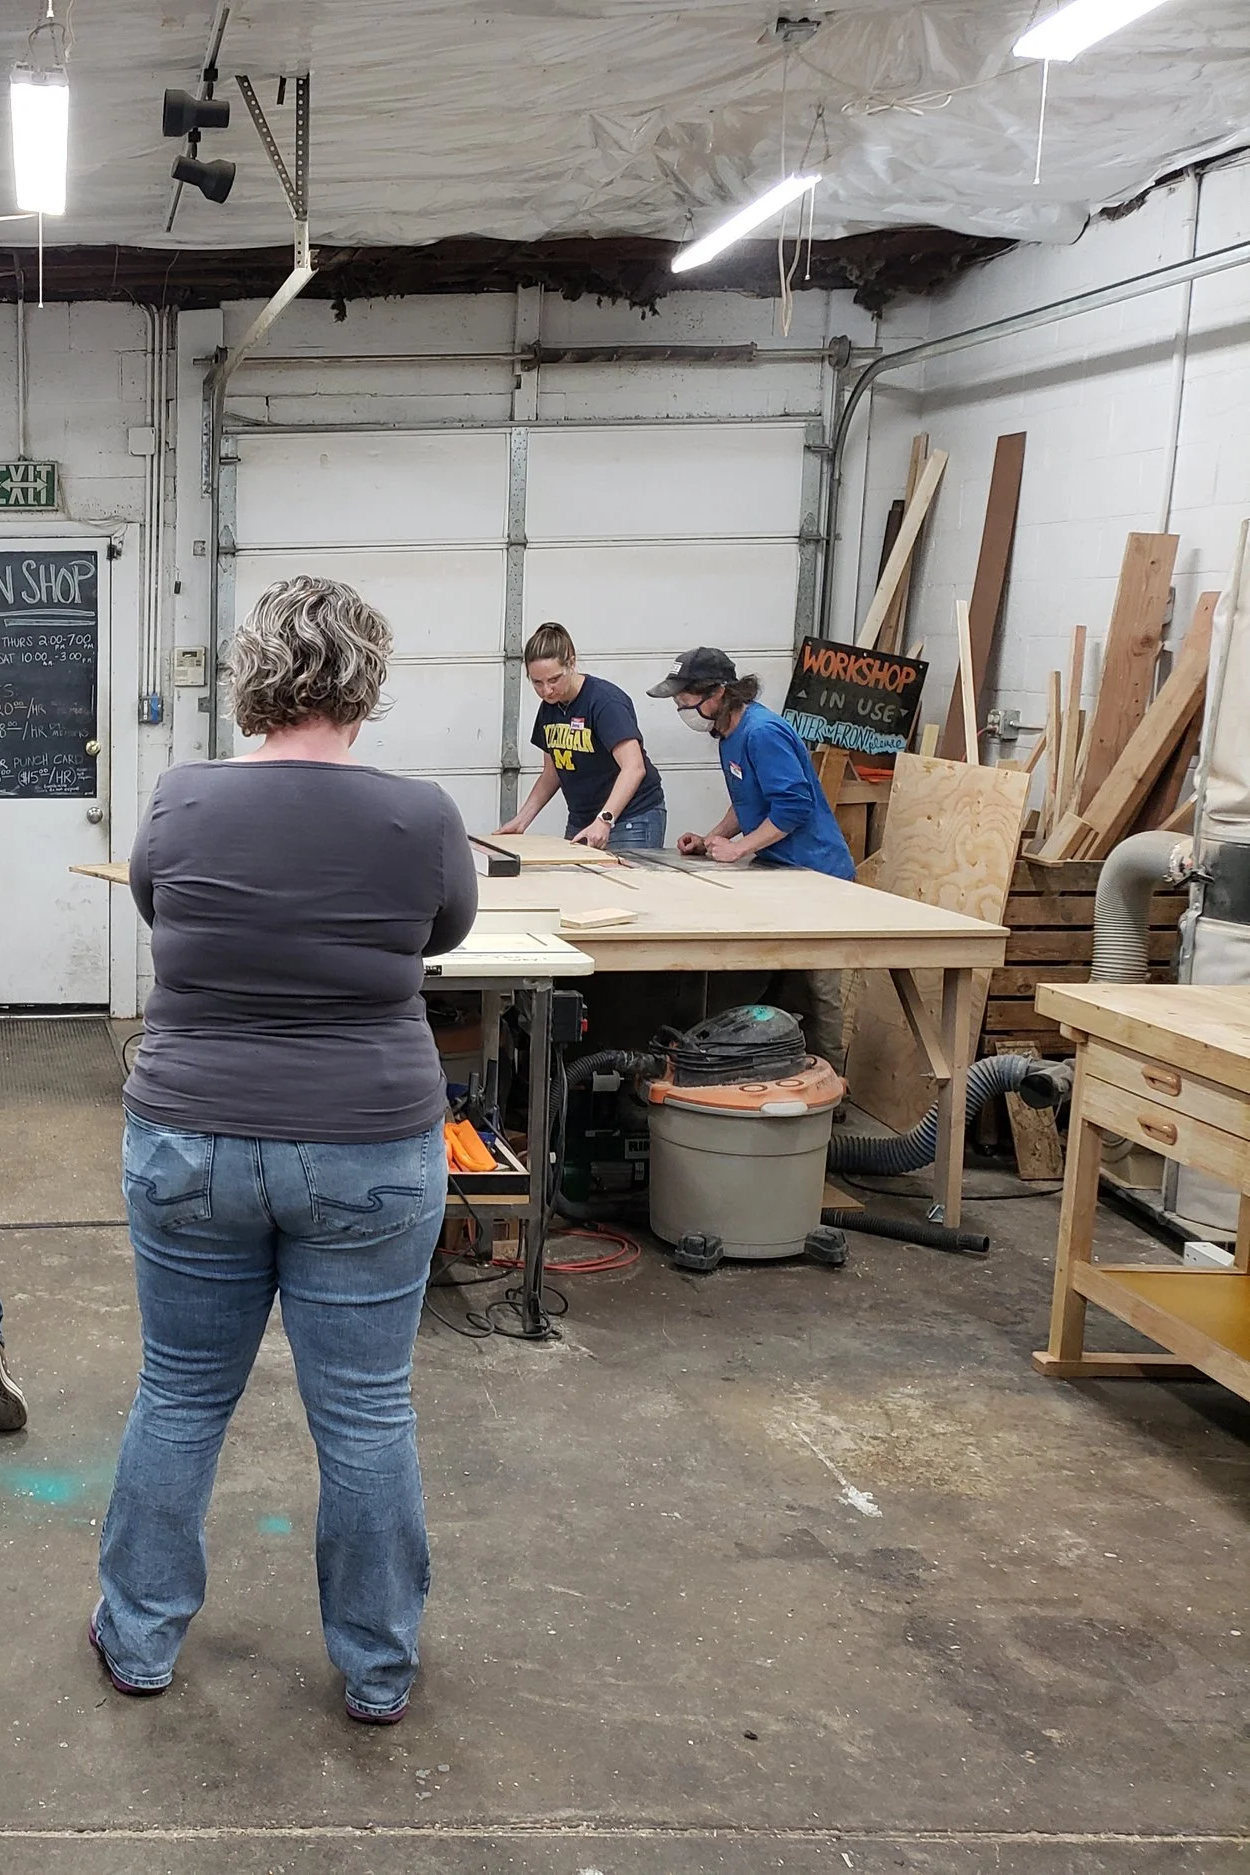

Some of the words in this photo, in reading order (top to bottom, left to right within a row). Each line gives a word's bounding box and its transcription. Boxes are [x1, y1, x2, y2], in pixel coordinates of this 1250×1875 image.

[21, 559, 96, 605] SHOP
[2, 636, 33, 648] THURS
[803, 645, 917, 693] WORKSHOP
[820, 688, 846, 709] IN
[857, 698, 897, 723] USE
[784, 709, 825, 742] ENTER
[832, 721, 875, 752] FRONT
[13, 752, 48, 769] PUNCH
[53, 753, 84, 765] CARD
[553, 749, 576, 771] M
